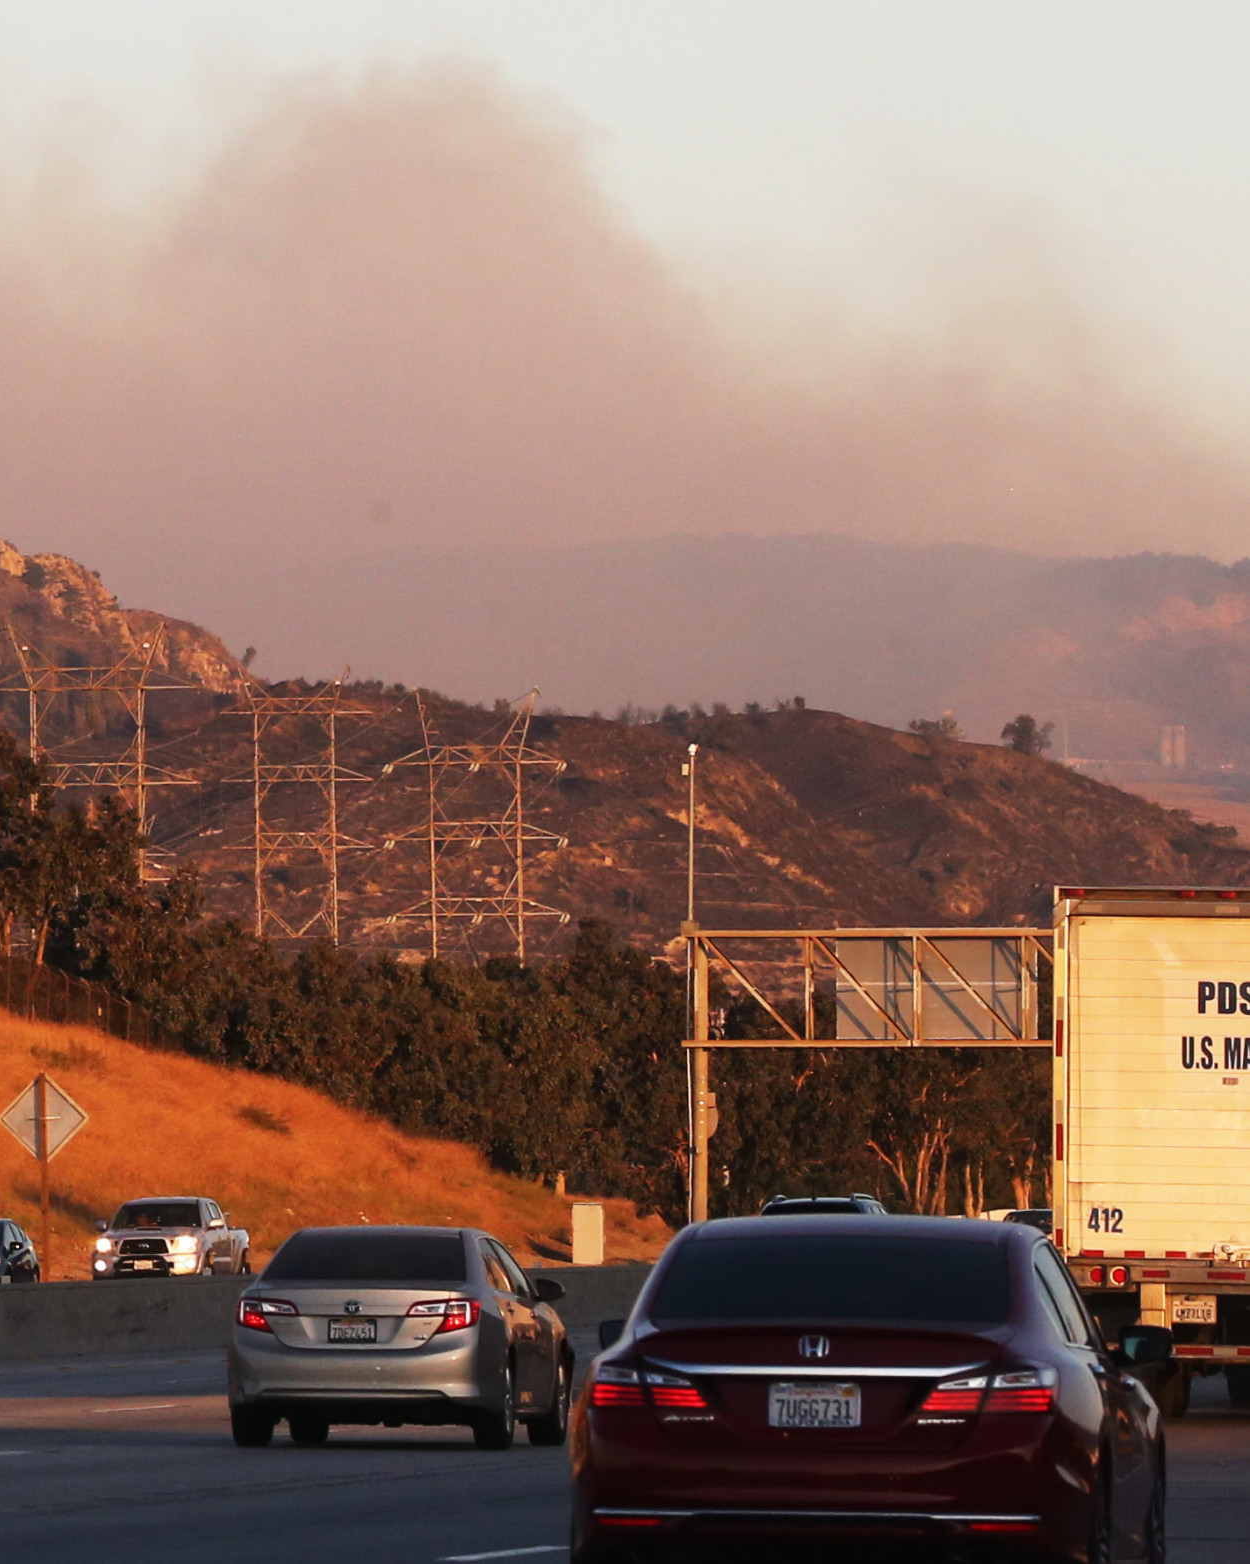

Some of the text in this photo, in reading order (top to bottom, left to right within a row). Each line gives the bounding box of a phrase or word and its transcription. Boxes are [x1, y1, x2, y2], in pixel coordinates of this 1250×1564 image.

[1197, 981, 1250, 1015] PDS
[1181, 1036, 1219, 1069] U.S.
[1087, 1207, 1123, 1233] 412
[775, 1399, 852, 1420] 7UGG731
